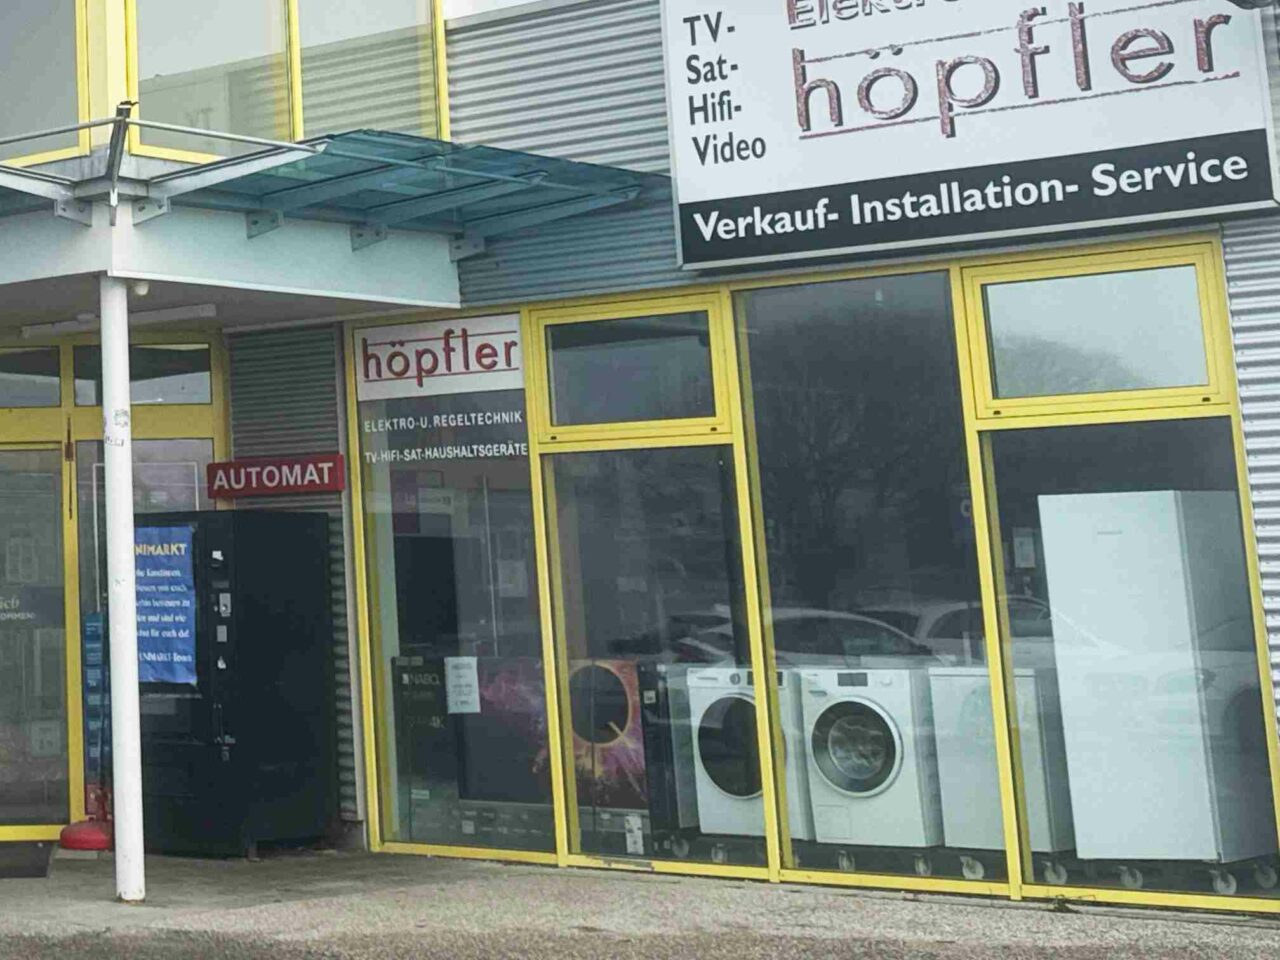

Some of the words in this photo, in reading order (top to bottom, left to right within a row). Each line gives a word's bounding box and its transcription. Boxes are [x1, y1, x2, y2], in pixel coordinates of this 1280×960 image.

[683, 11, 736, 46] TV-
[686, 54, 739, 85] Sat-
[792, 2, 1233, 139] höpfler
[689, 92, 743, 126] Hifi-
[692, 134, 767, 167] Video
[693, 197, 840, 243] Verkauf-
[851, 176, 1079, 226] Installation-
[1091, 151, 1249, 200] Service
[362, 328, 518, 388] höpfler
[433, 410, 522, 428] REGELTECHNIK
[213, 462, 333, 491] AUTOMAT
[133, 543, 188, 556] NIMARKT
